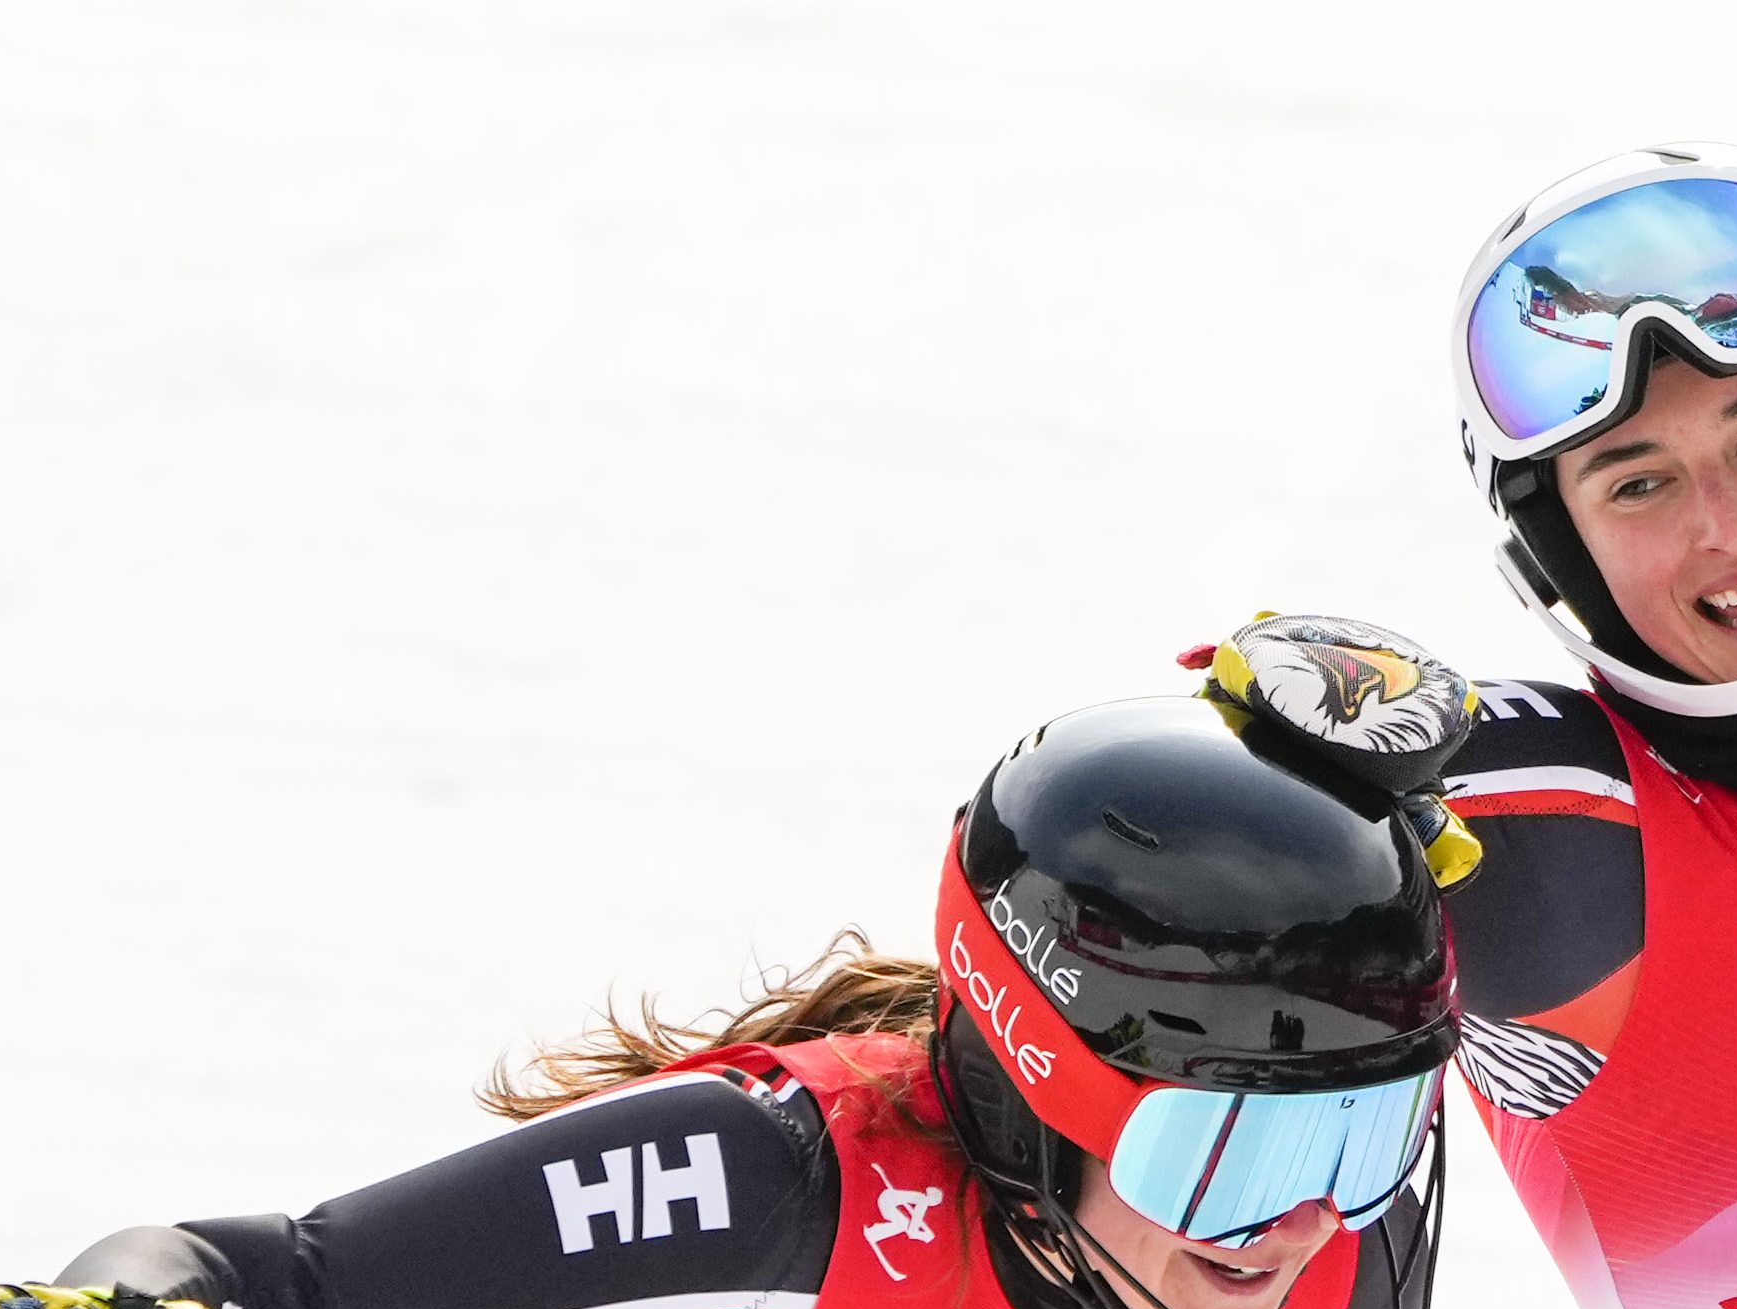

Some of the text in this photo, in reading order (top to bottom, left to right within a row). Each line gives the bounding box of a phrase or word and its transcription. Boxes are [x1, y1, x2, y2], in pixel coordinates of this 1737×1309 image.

[1470, 680, 1563, 721] H
[950, 920, 1057, 1085] bollé
[989, 878, 1083, 1006] bollé
[543, 1133, 731, 1256] HH
